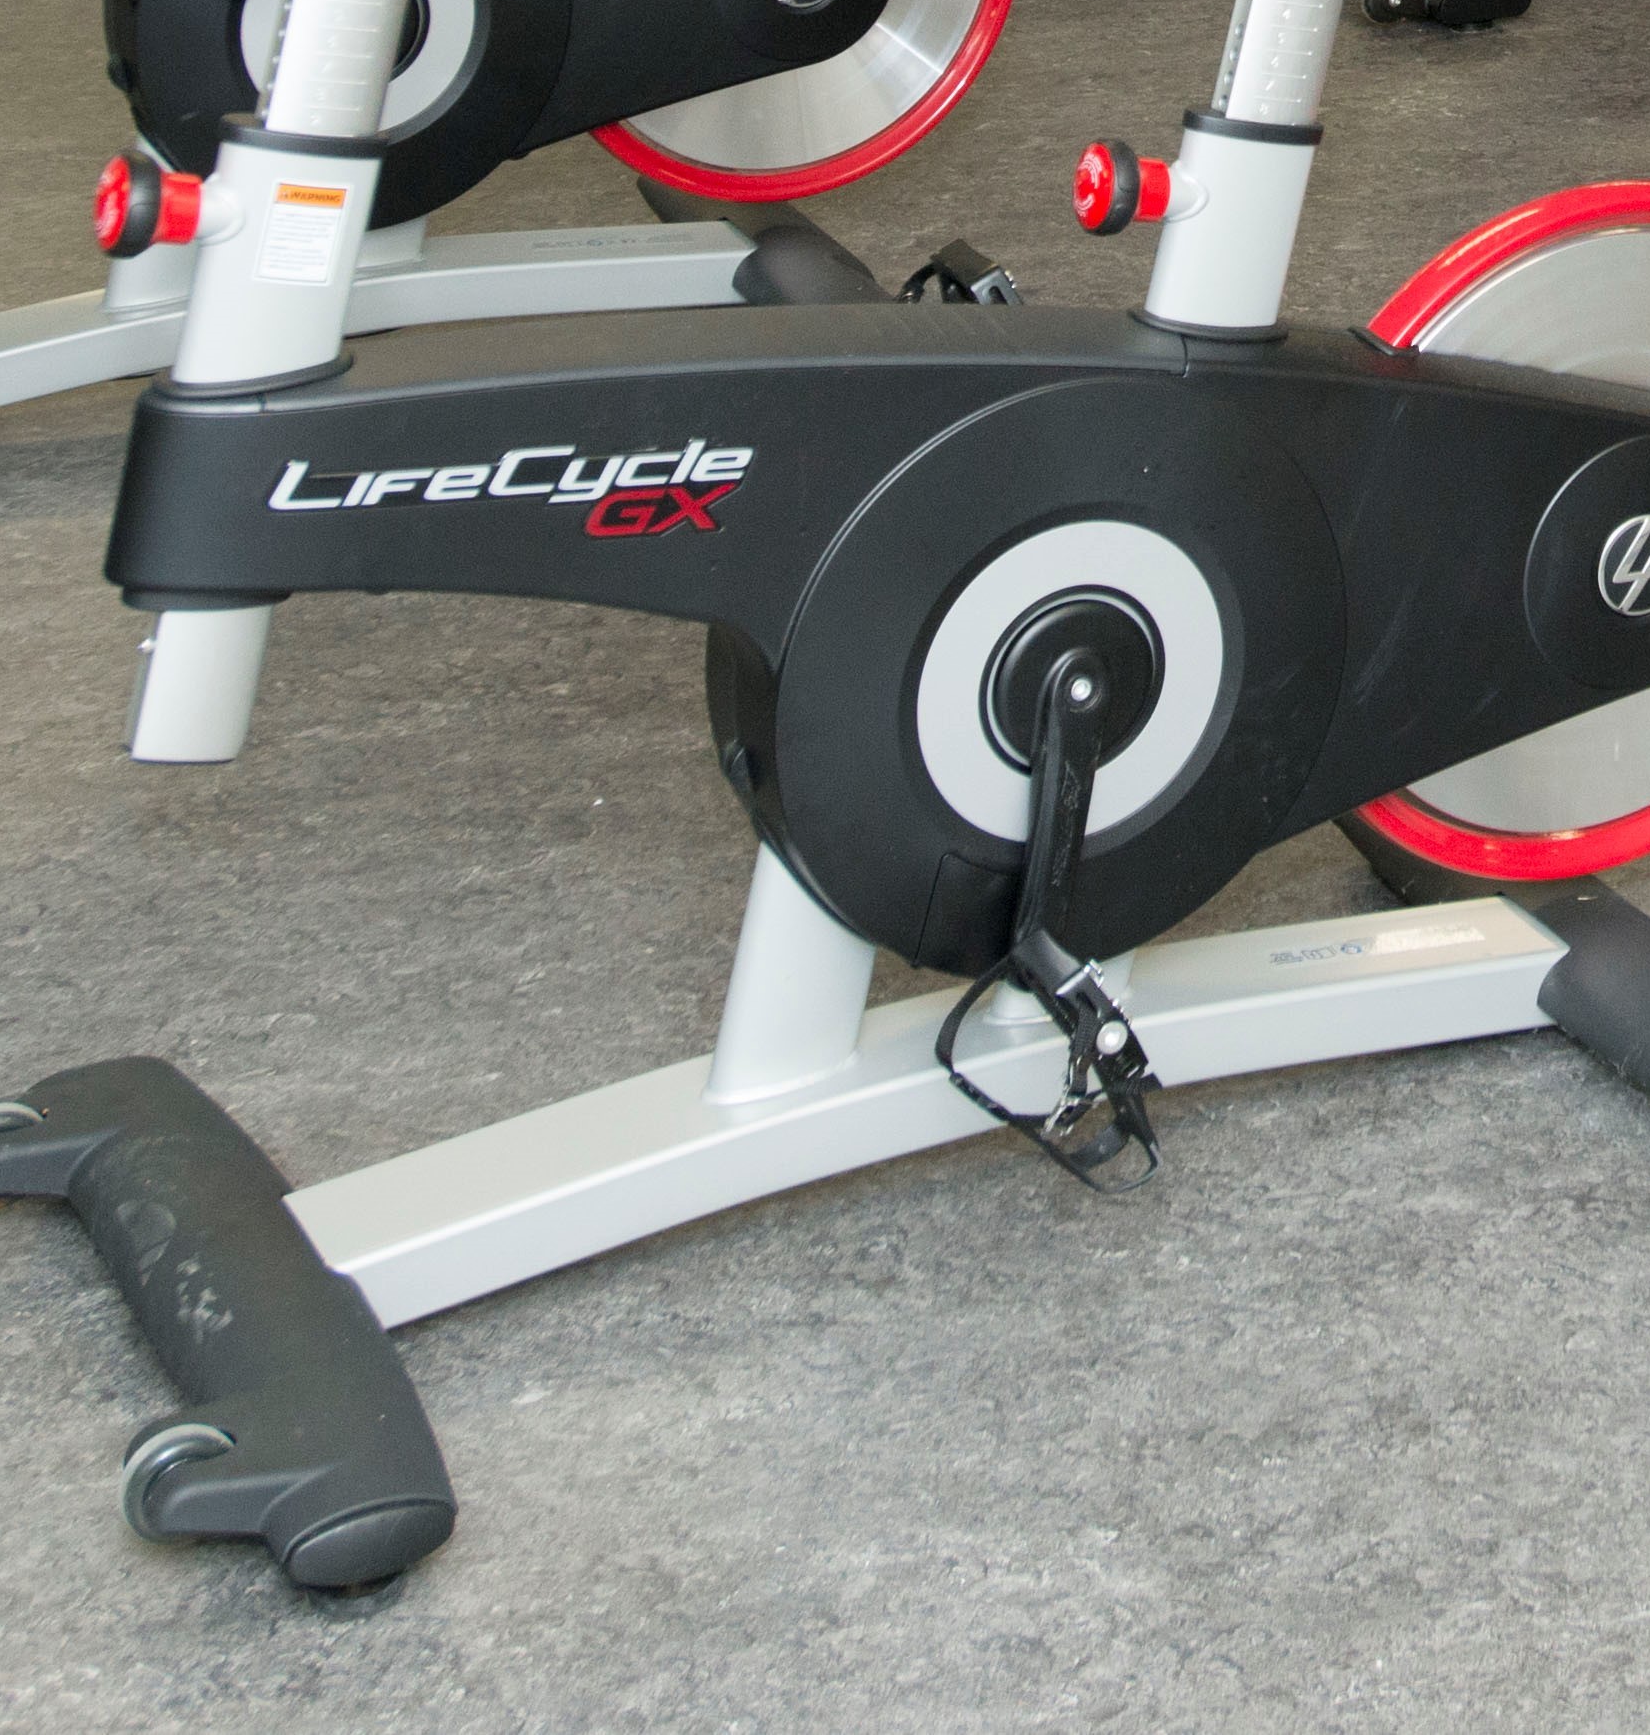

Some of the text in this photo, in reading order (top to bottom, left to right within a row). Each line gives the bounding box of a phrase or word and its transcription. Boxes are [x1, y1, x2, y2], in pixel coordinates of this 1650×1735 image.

[291, 191, 341, 203] WARNING
[267, 438, 755, 511] LifeCycle
[584, 482, 736, 538] GX
